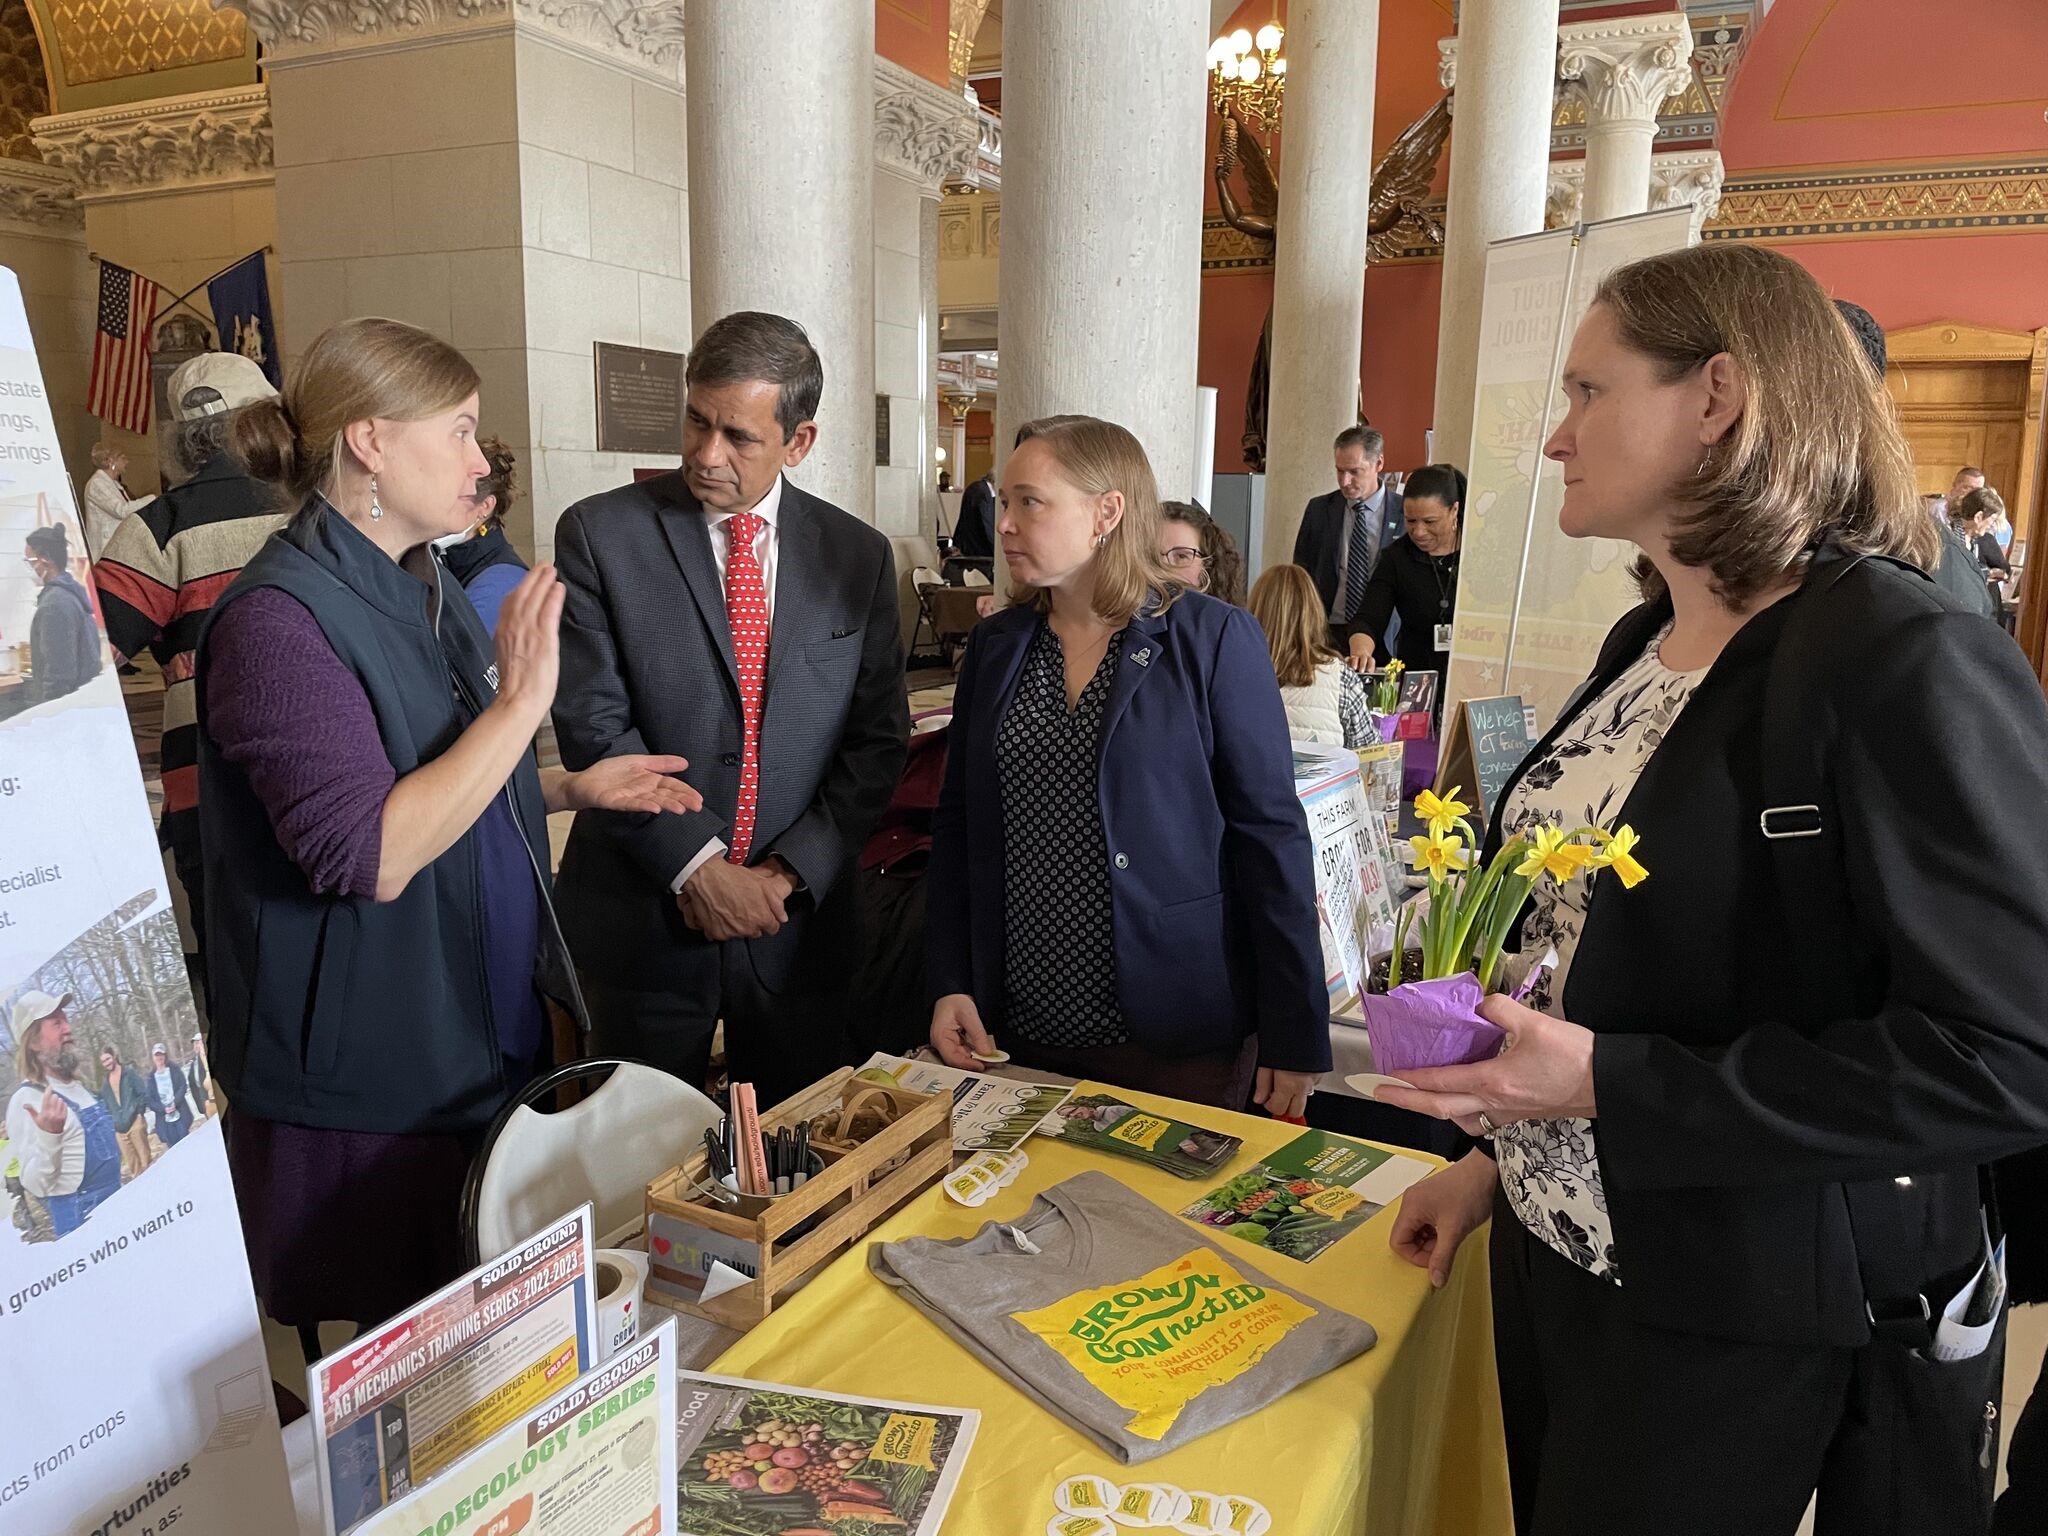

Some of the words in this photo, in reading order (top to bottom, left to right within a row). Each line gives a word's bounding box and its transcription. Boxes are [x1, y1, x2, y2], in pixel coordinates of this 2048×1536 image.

[1470, 705, 1495, 730] We
[1479, 732, 1497, 753] CT
[1317, 806, 1336, 829] THIS
[1335, 799, 1356, 820] FARM
[1355, 827, 1373, 858] FOR
[9, 1257, 87, 1315] growers
[90, 1236, 129, 1265] who
[132, 1208, 174, 1243] want
[176, 1199, 194, 1217] to
[481, 1255, 522, 1289] SOLID
[523, 1221, 578, 1262] GROUND
[673, 1242, 699, 1269] CT
[622, 1314, 633, 1328] CT
[1068, 1273, 1221, 1342] GROWN
[332, 1392, 352, 1423] AG
[353, 1346, 426, 1409] MECHANICS
[427, 1311, 481, 1363] TRAINING
[483, 1287, 522, 1331] SERIES:
[524, 1250, 579, 1301] 2022-2023
[1112, 1362, 1147, 1379] YOUR
[1154, 1328, 1228, 1369] COMMUNITY
[1166, 1331, 1246, 1379] NORTHEAST
[1247, 1314, 1283, 1336] CONN
[546, 1360, 562, 1379] SOLD
[561, 1349, 573, 1364] OUT
[537, 1390, 586, 1433] SOLID
[588, 1344, 654, 1395] GROUND
[577, 1374, 656, 1438] SERIES
[0, 1474, 30, 1506] cts
[34, 1444, 75, 1481] from
[79, 1409, 126, 1450] crops
[883, 1421, 908, 1455] GROWN
[158, 1504, 184, 1533] as:
